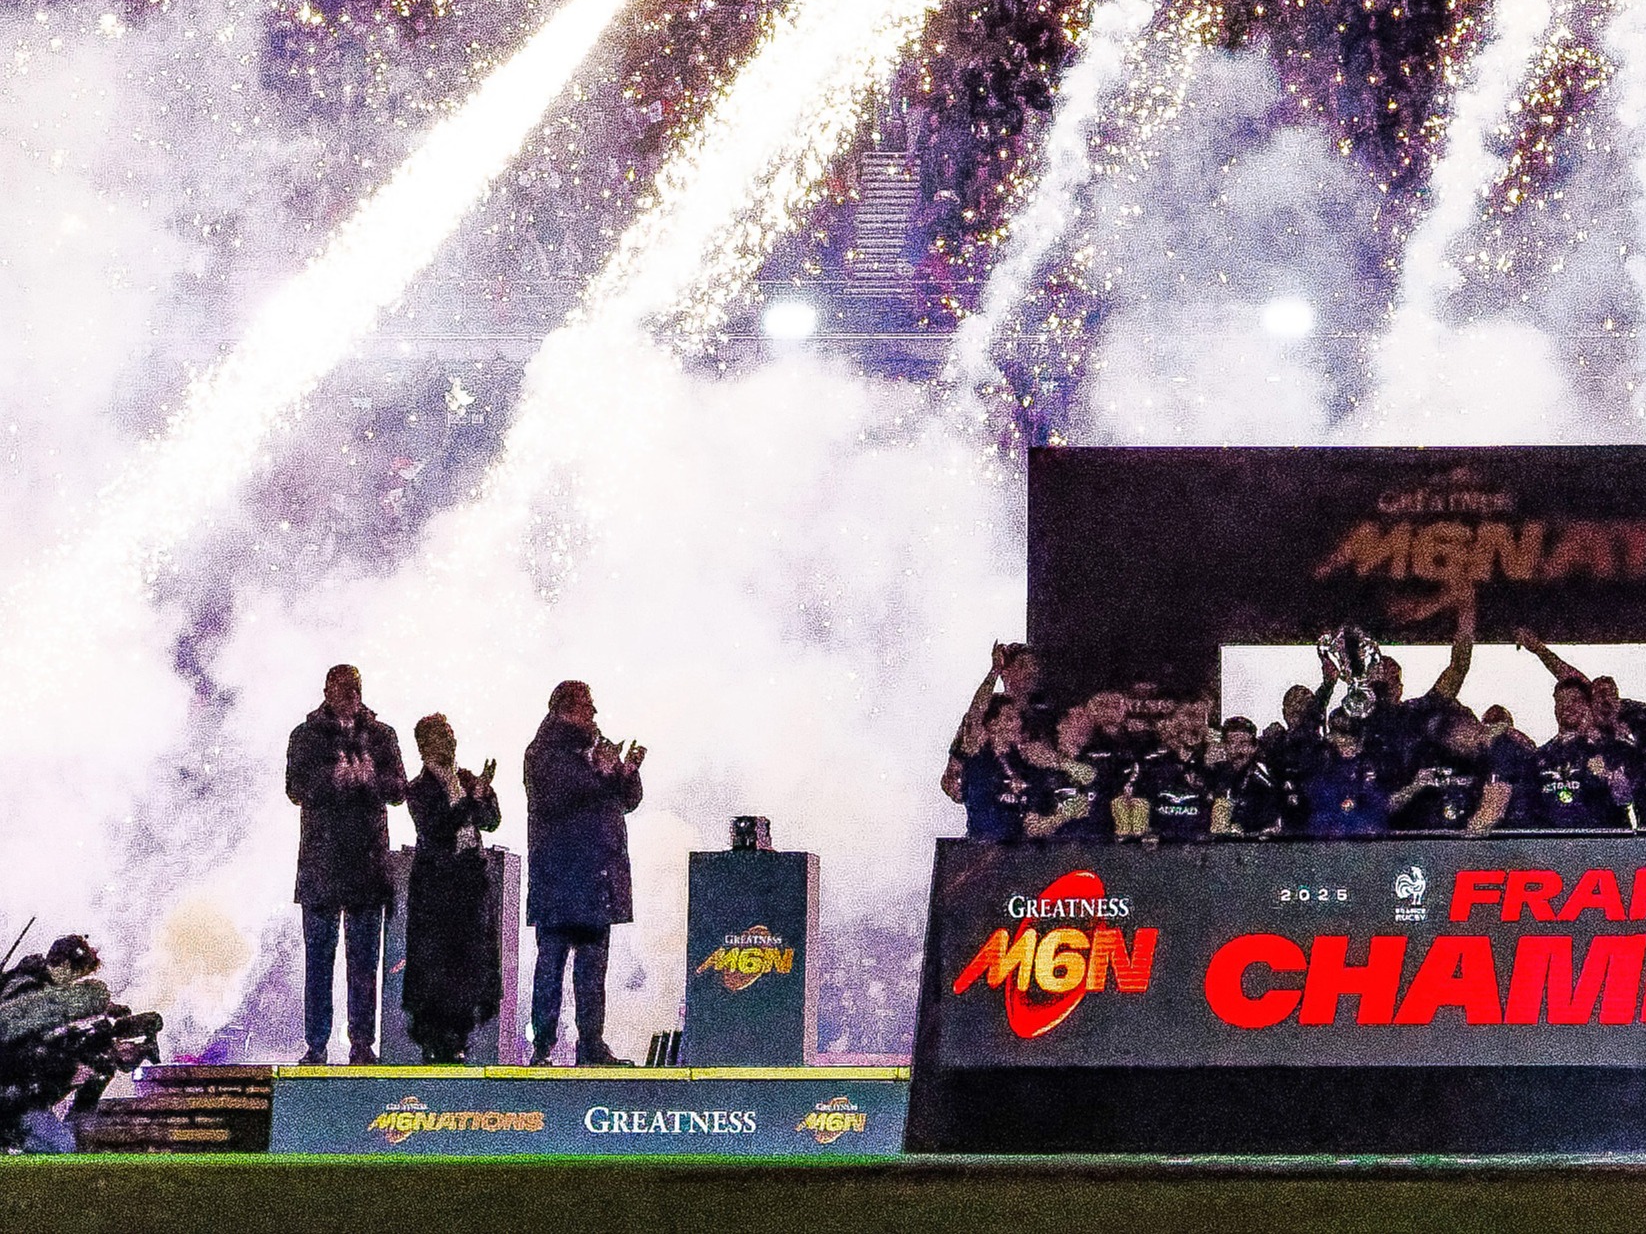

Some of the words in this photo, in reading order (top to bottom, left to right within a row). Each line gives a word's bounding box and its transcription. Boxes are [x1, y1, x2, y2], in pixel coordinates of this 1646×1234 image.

[1007, 893, 1130, 921] GREATNESS
[1280, 888, 1348, 902] 2025
[584, 1106, 757, 1134] GREATNESS
